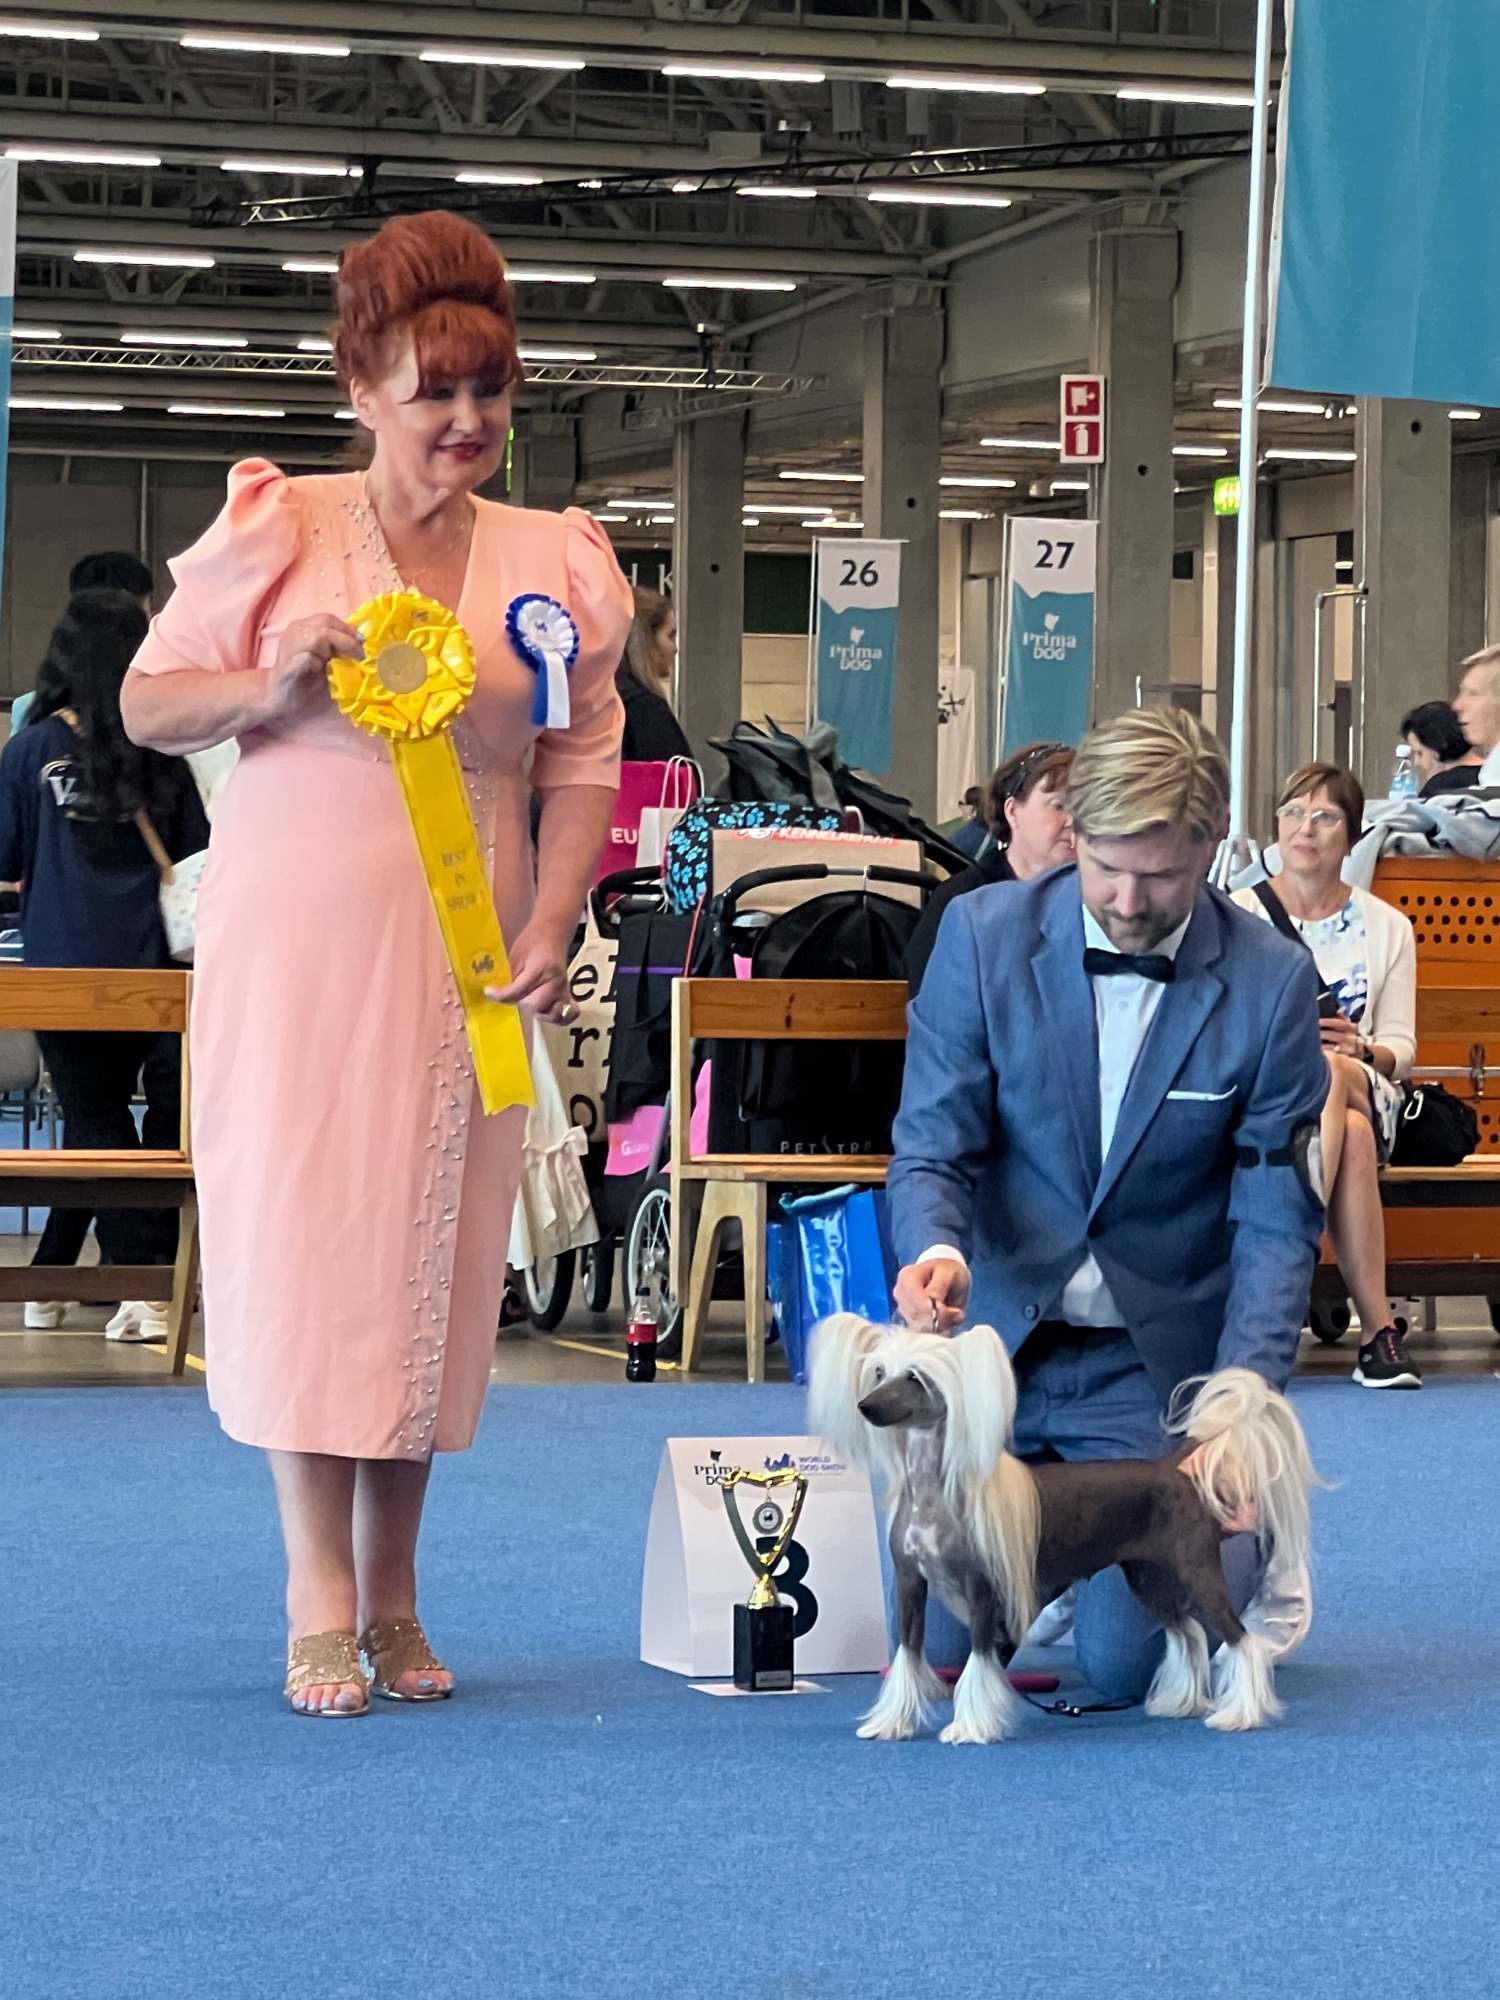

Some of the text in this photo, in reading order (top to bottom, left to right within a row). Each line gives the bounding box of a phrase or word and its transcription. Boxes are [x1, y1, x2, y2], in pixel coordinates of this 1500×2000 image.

[1034, 540, 1075, 570] 27
[839, 560, 879, 587] 26
[1022, 631, 1077, 648] Prima
[829, 644, 883, 659] Prima
[1033, 647, 1066, 661] DOG
[840, 659, 872, 671] DOG
